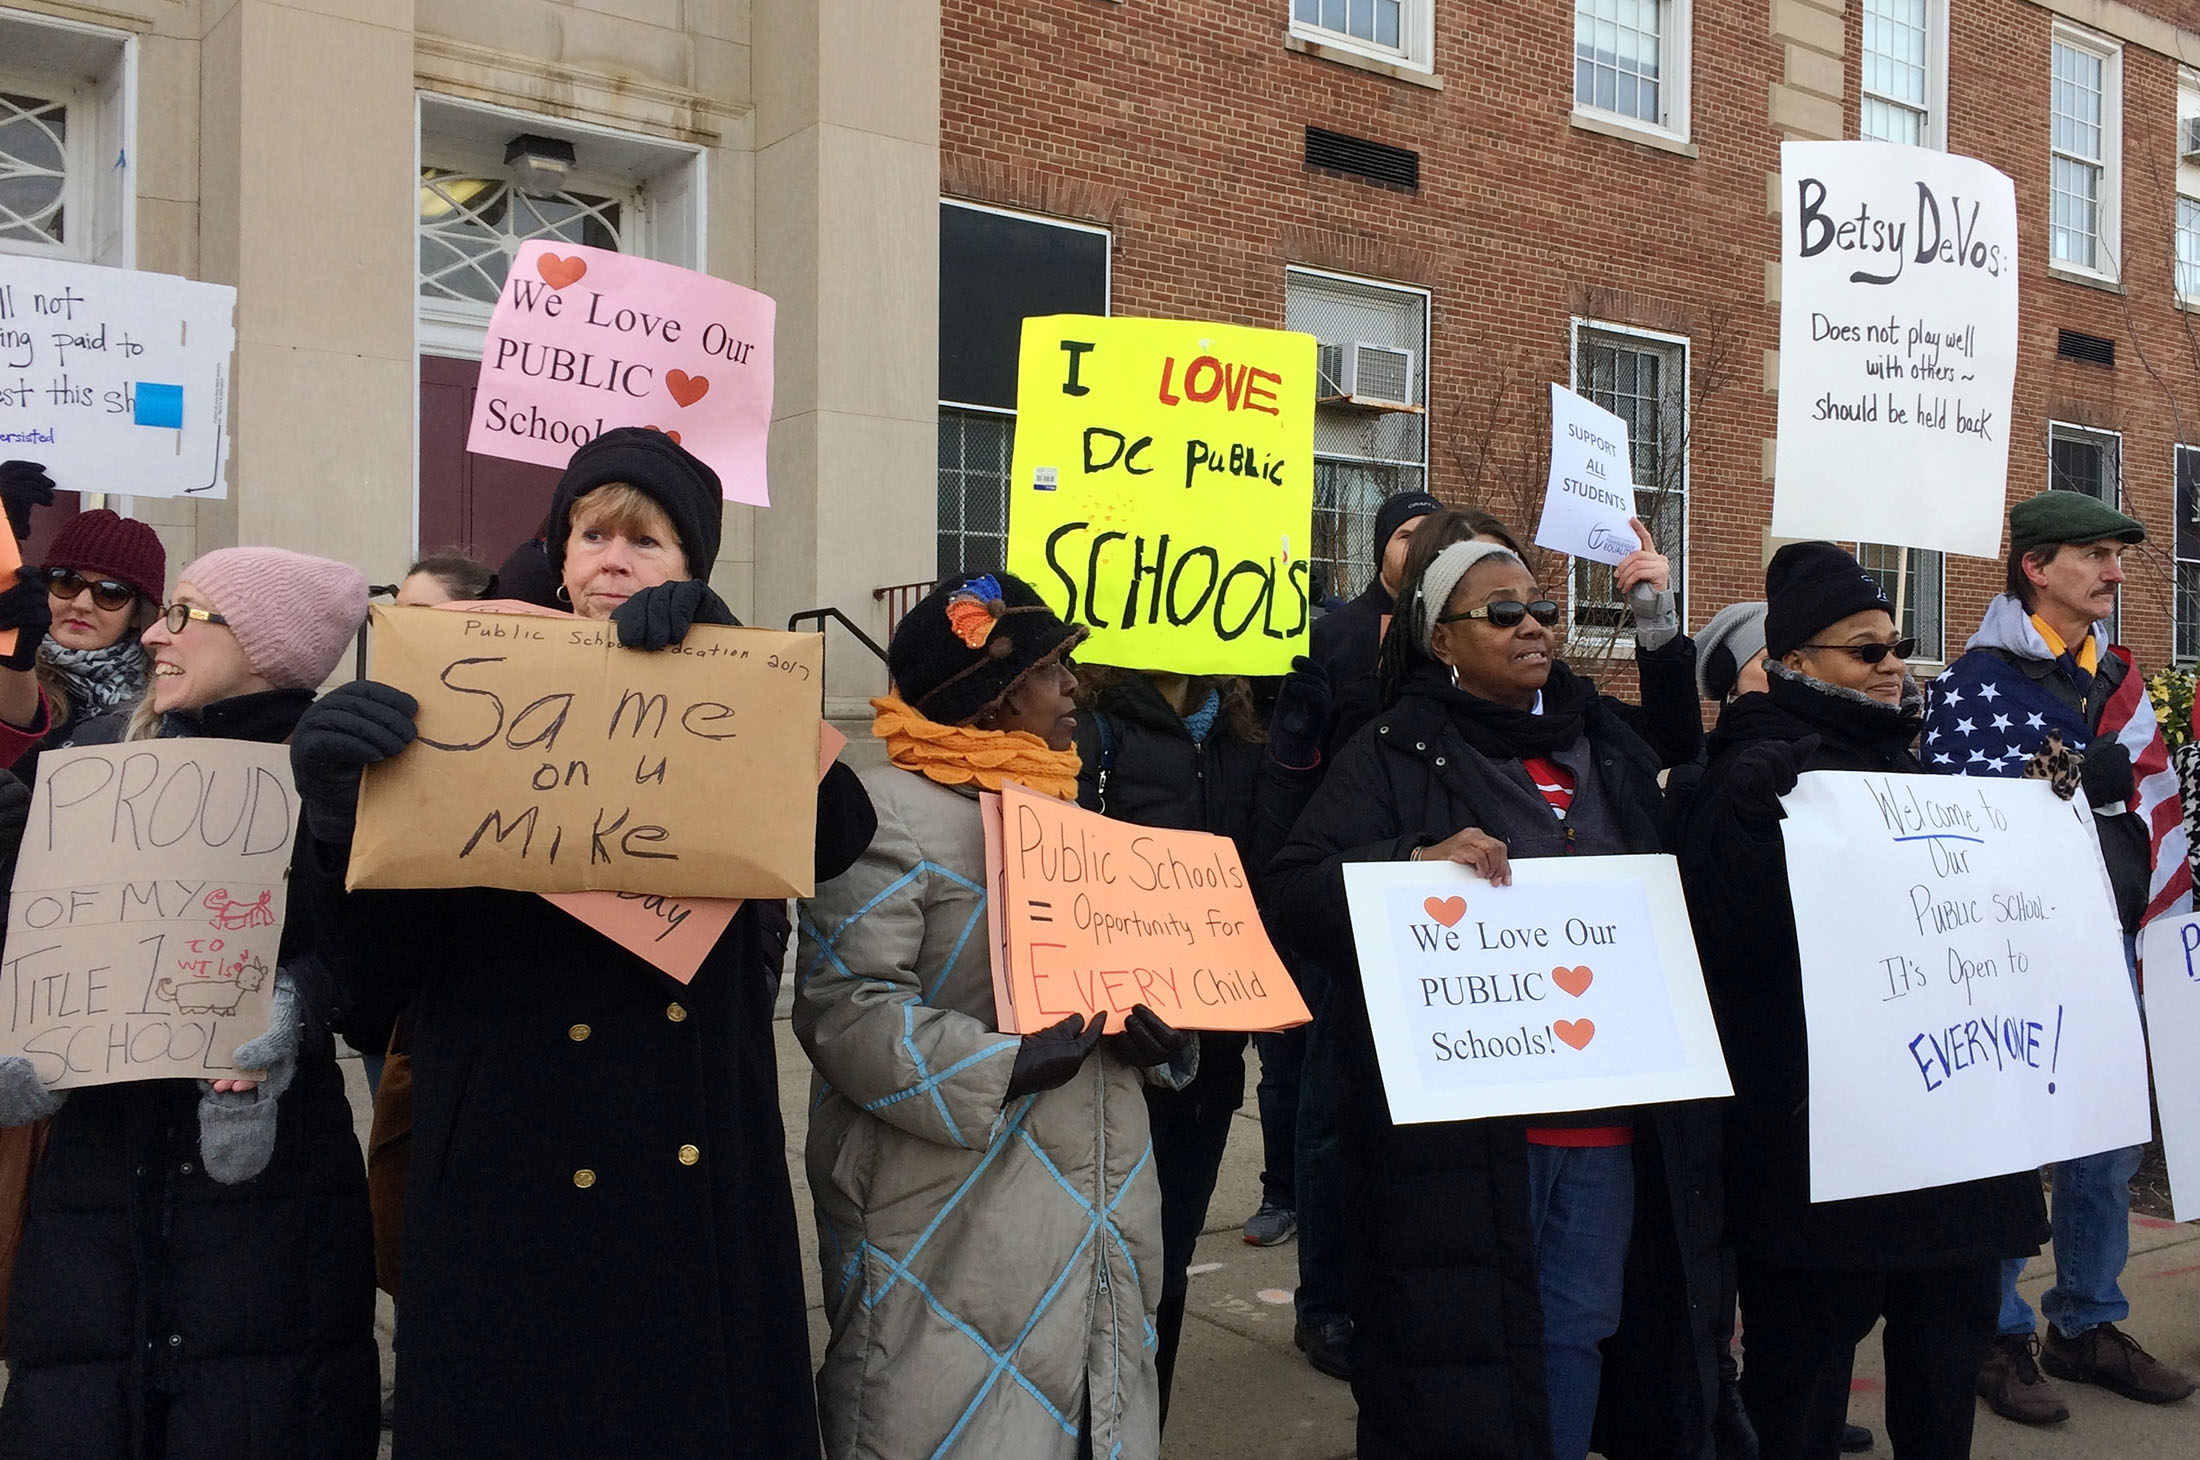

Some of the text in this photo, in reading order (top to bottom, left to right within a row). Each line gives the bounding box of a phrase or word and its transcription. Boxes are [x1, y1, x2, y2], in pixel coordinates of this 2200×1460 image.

[1798, 178, 2008, 285] Betsy DeVos:
[34, 286, 84, 320] not
[513, 278, 755, 365] We Love Our
[52, 323, 107, 367] paid
[116, 333, 144, 358] to
[1812, 312, 1975, 367] Does not play well
[46, 373, 93, 407] this
[494, 337, 653, 398] PUBLIC
[1060, 340, 1282, 416] I LOVE
[1867, 354, 1903, 380] with
[1911, 354, 1954, 382] others
[486, 398, 604, 449] School
[1568, 423, 1616, 458] SUPPORT
[1889, 393, 1908, 424] be
[1917, 393, 1946, 430] held
[1957, 399, 1992, 442] back
[1083, 427, 1154, 475] DC
[1586, 458, 1606, 477] ALL
[1562, 477, 1626, 512] STUDENTS
[1603, 543, 1634, 557] EQUALIT
[1045, 522, 1309, 642] SCHOOLS
[465, 620, 545, 640] Public
[568, 631, 632, 651] Schoo
[767, 655, 810, 681] 2017
[532, 755, 667, 791] on u
[47, 752, 290, 856] PROUD
[1864, 778, 2008, 833] Welcome to
[1018, 805, 1244, 891] Public Schools
[1928, 836, 1970, 879] Our
[25, 880, 206, 928] OF MY
[1074, 893, 1195, 946] Opportunity
[1206, 908, 1245, 938] for
[184, 939, 225, 953] TO
[1409, 917, 1617, 953] We Love Our
[4, 945, 111, 1032] TITLE
[1030, 942, 1267, 1014] EVERY Child
[1419, 972, 1547, 1008] PUBLIC
[1879, 939, 2029, 1006] It's Open to
[23, 1021, 233, 1085] SCHOOL
[1431, 1025, 1557, 1062] Schools!
